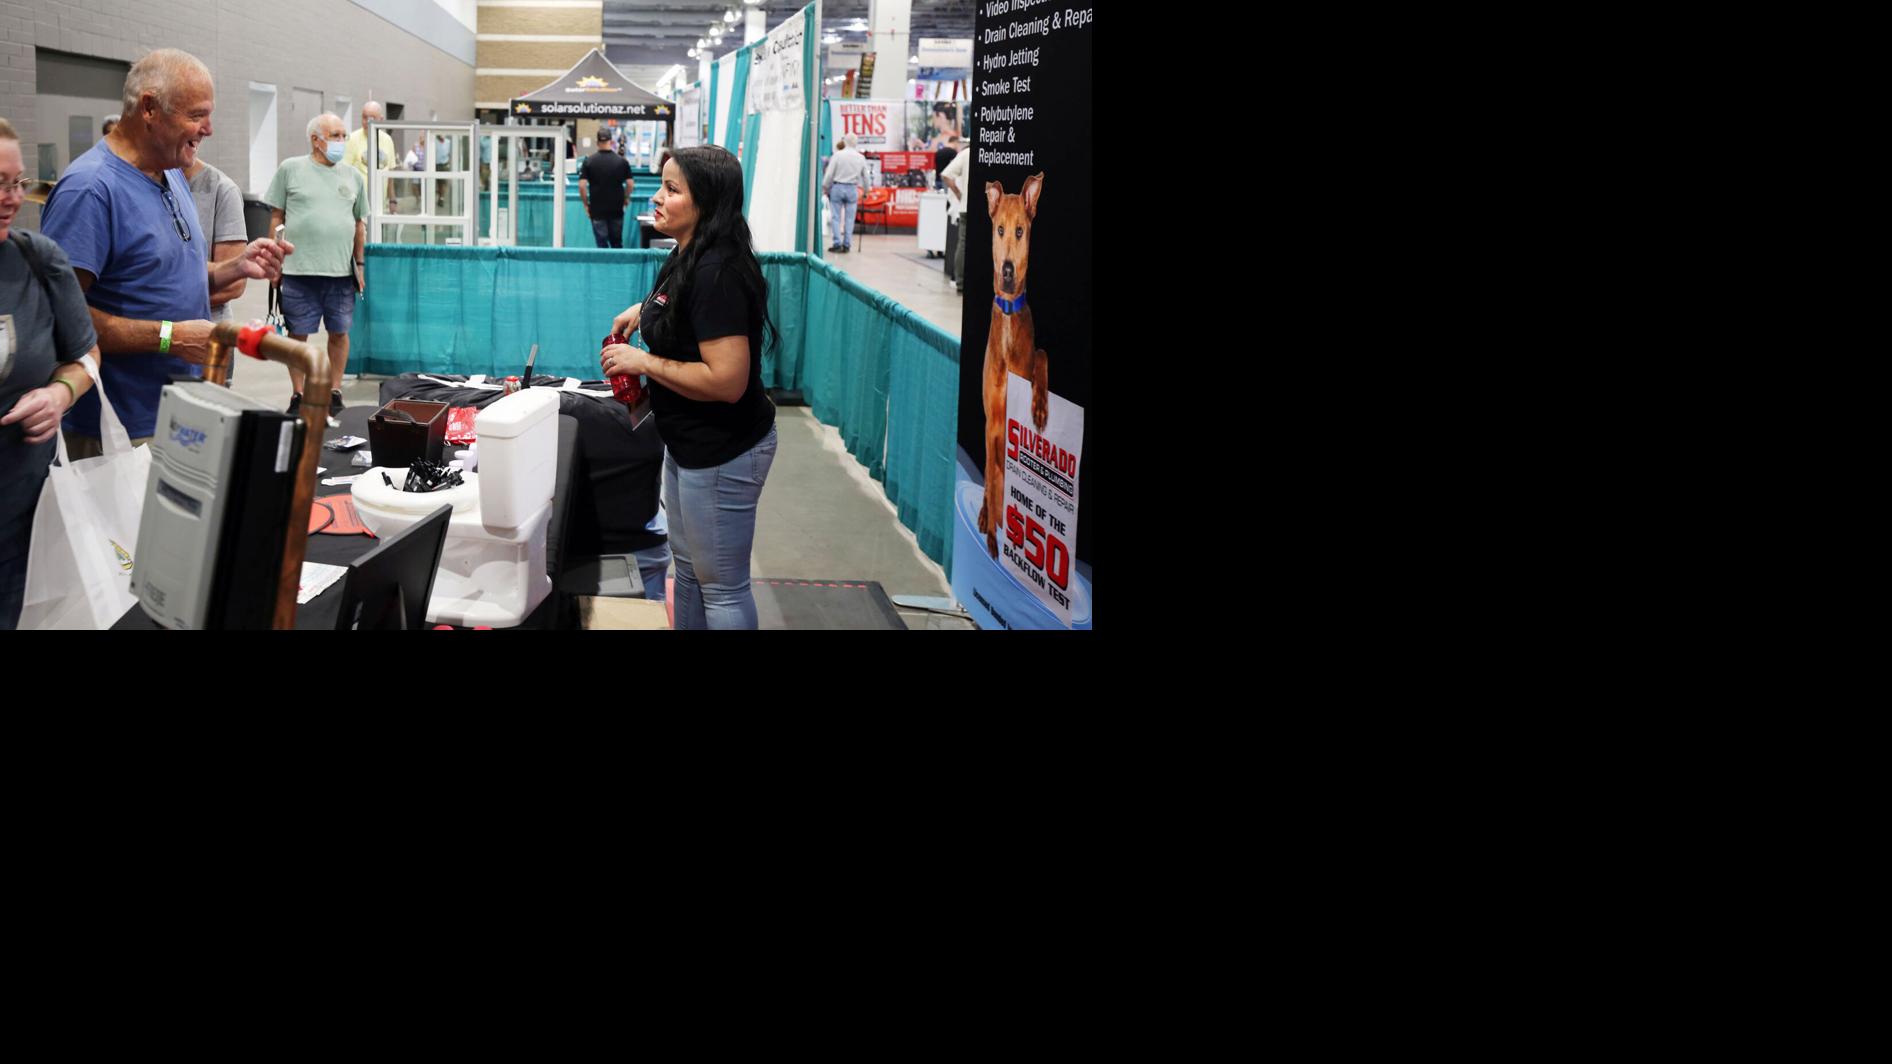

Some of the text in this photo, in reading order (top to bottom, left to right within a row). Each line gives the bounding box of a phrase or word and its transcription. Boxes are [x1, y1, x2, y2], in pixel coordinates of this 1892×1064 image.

[986, 1, 1009, 18] Video
[984, 25, 1007, 45] Drain
[1008, 16, 1050, 38] Cleaning
[1052, 11, 1061, 30] &
[983, 47, 1040, 73] Hydro Jetting
[981, 76, 1031, 97] Smoke Test
[541, 102, 646, 115] solarsolutionaz.net
[980, 104, 1034, 125] Polybutylene
[841, 112, 886, 136] TENS
[979, 126, 1015, 146] Repair &
[978, 148, 1034, 167] Replacement
[1007, 417, 1077, 479] SILVERADO
[1010, 485, 1067, 537] HOME OF THE
[1005, 503, 1070, 591] $50
[1003, 543, 1046, 590] BACKFLOW
[1048, 583, 1071, 610] TEST
